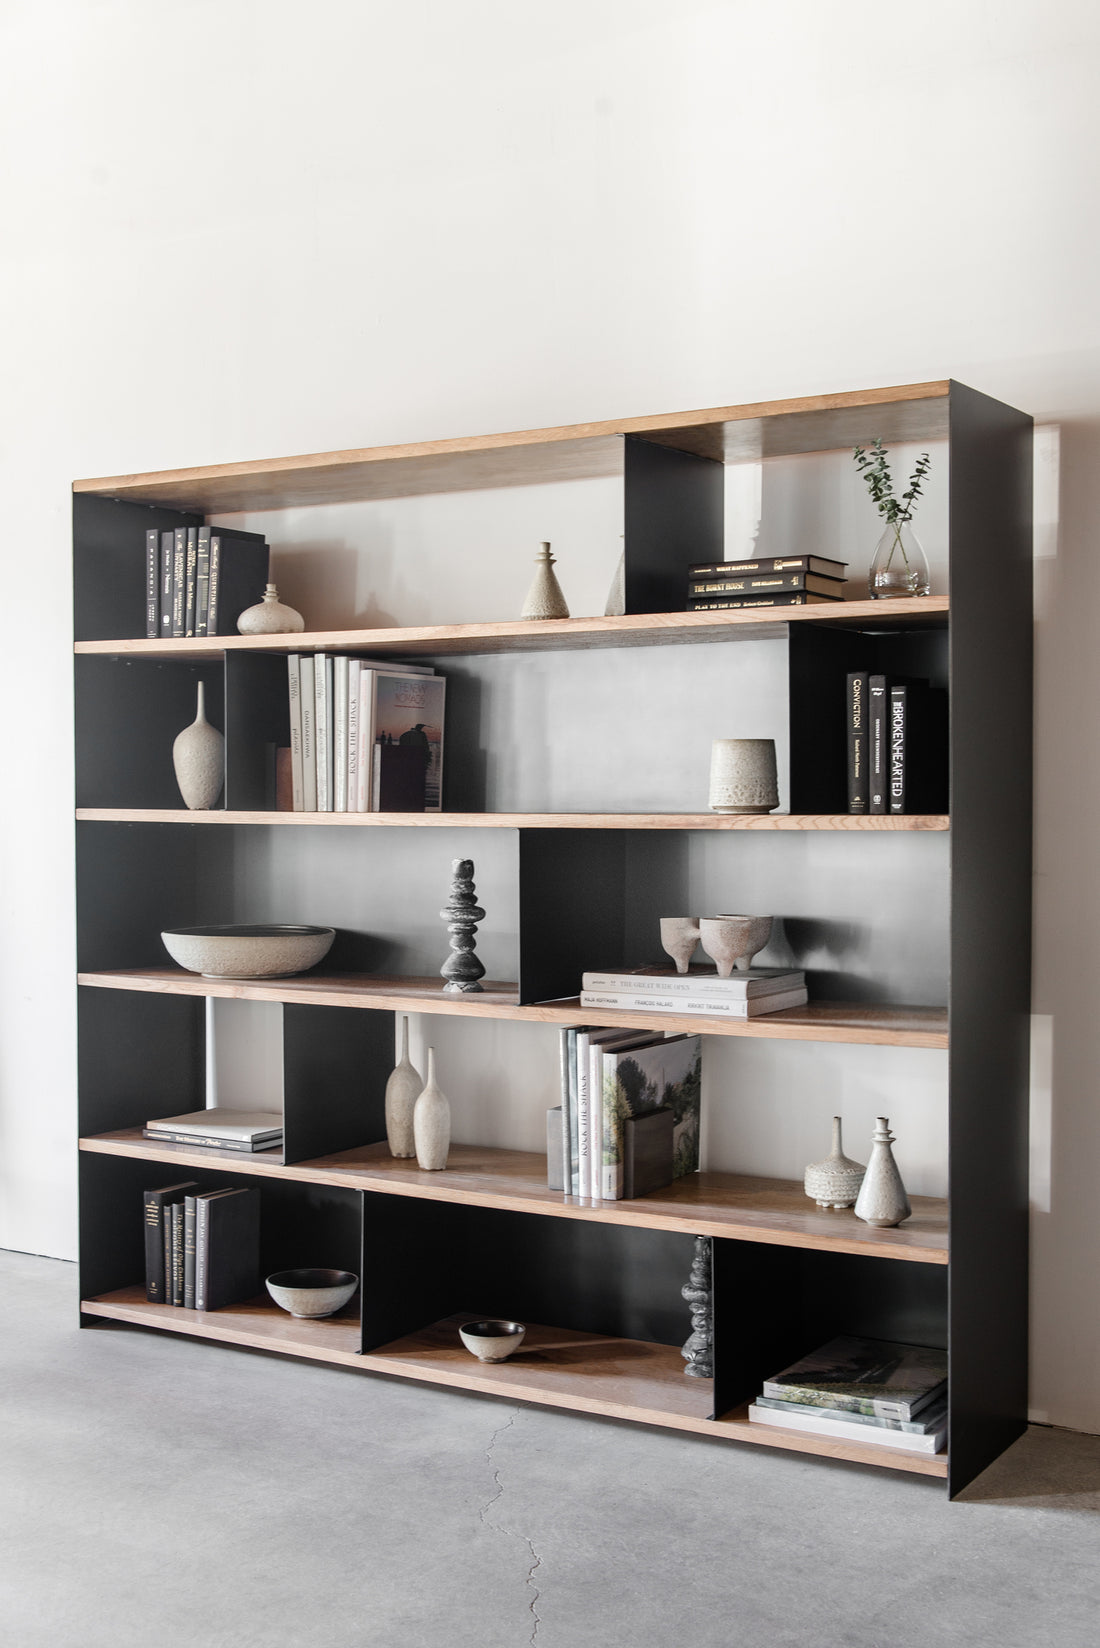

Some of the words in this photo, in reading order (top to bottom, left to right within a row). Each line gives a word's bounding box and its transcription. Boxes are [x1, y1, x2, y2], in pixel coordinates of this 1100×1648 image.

[694, 585, 705, 593] THE
[725, 581, 745, 591] HOUSE
[853, 679, 862, 728] CONVICTION
[892, 706, 904, 797] BROKENHEARTED
